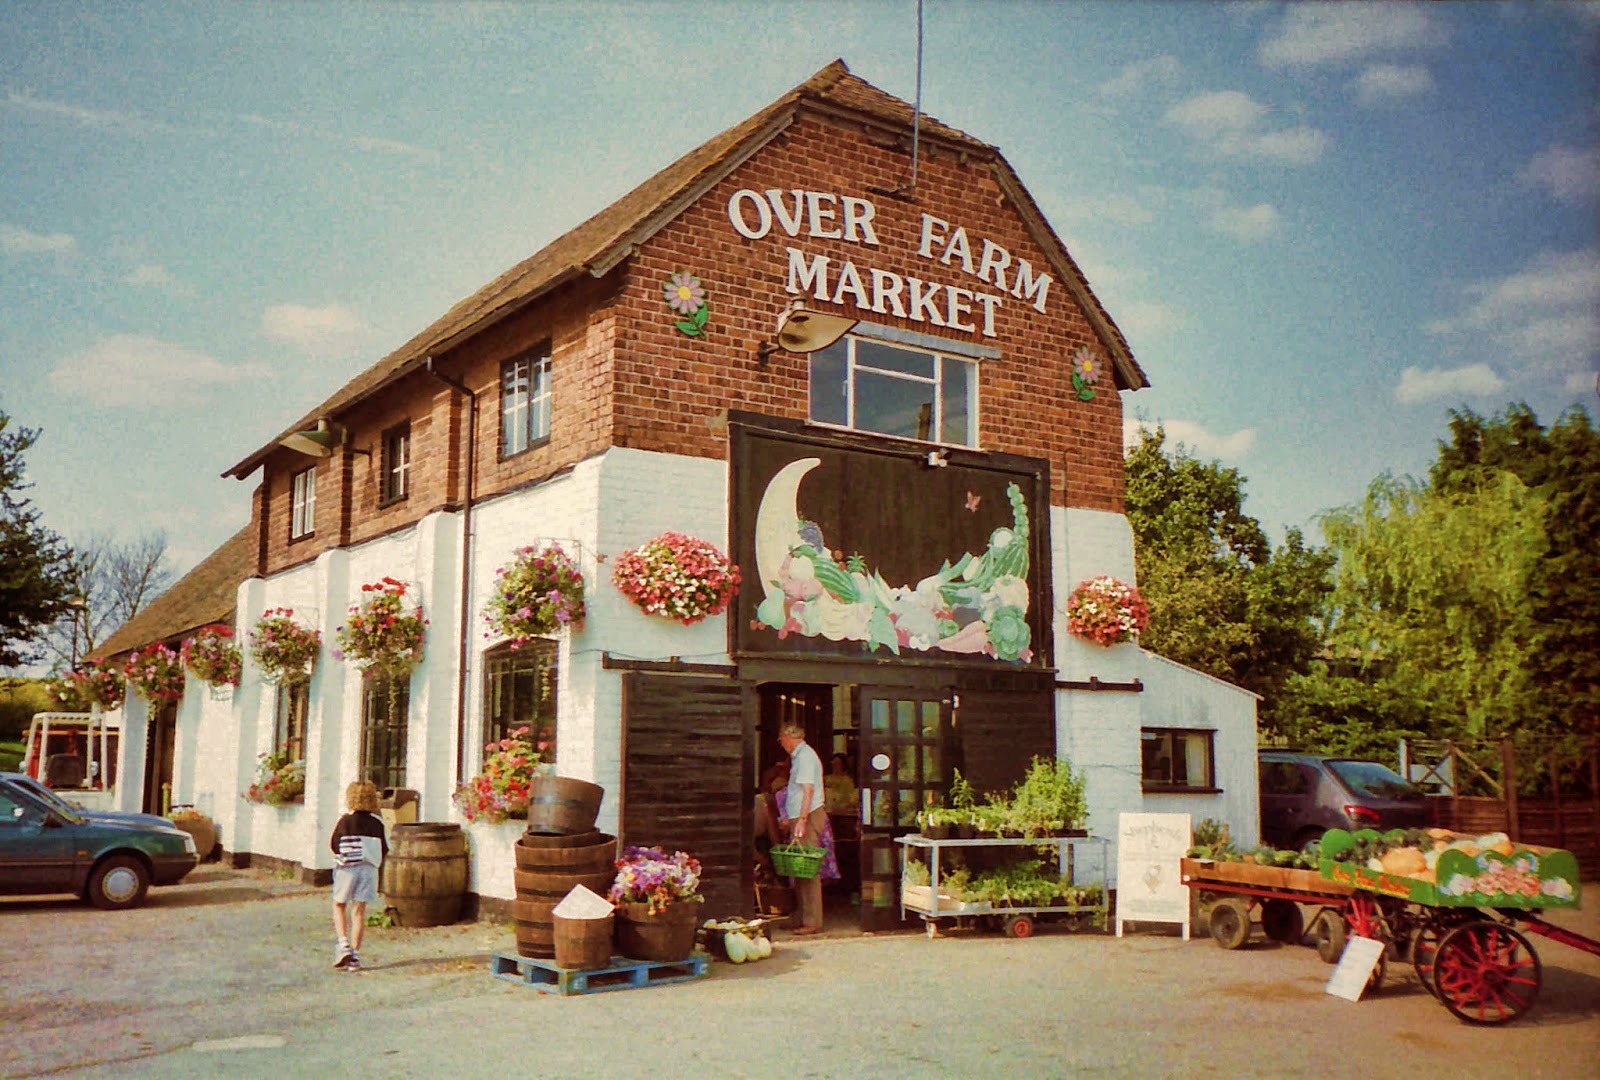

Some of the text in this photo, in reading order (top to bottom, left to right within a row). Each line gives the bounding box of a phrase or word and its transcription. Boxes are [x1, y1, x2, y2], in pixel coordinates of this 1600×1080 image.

[728, 189, 1054, 315] OVER FARM
[785, 246, 1002, 338] MARKET
